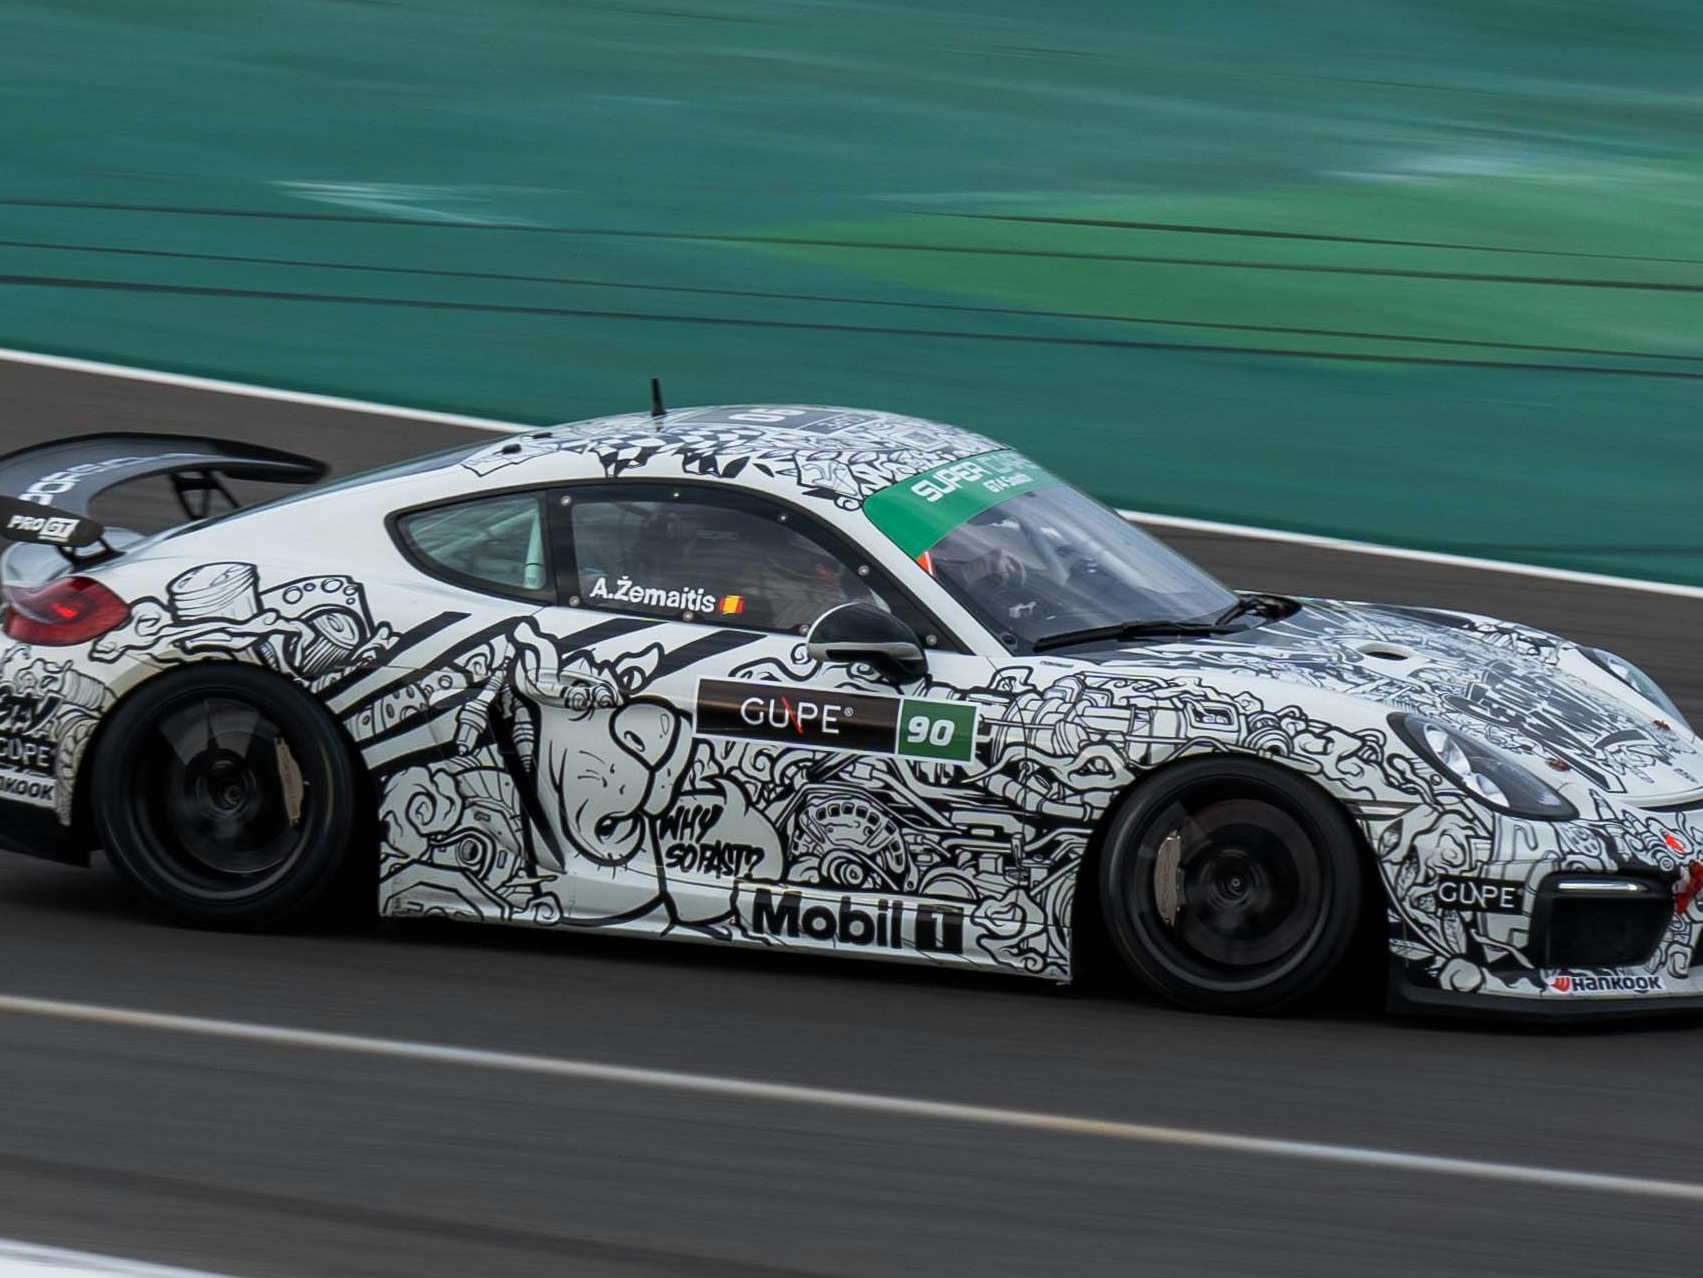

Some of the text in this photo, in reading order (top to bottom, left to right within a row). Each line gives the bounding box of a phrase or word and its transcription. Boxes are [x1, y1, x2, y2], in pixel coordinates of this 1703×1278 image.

[910, 460, 993, 503] SUPER
[589, 575, 716, 613] A.Žemaitis
[907, 715, 955, 747] 90
[658, 803, 724, 844] WHY
[665, 840, 765, 880] SO FAST?
[752, 888, 904, 950] Mobil
